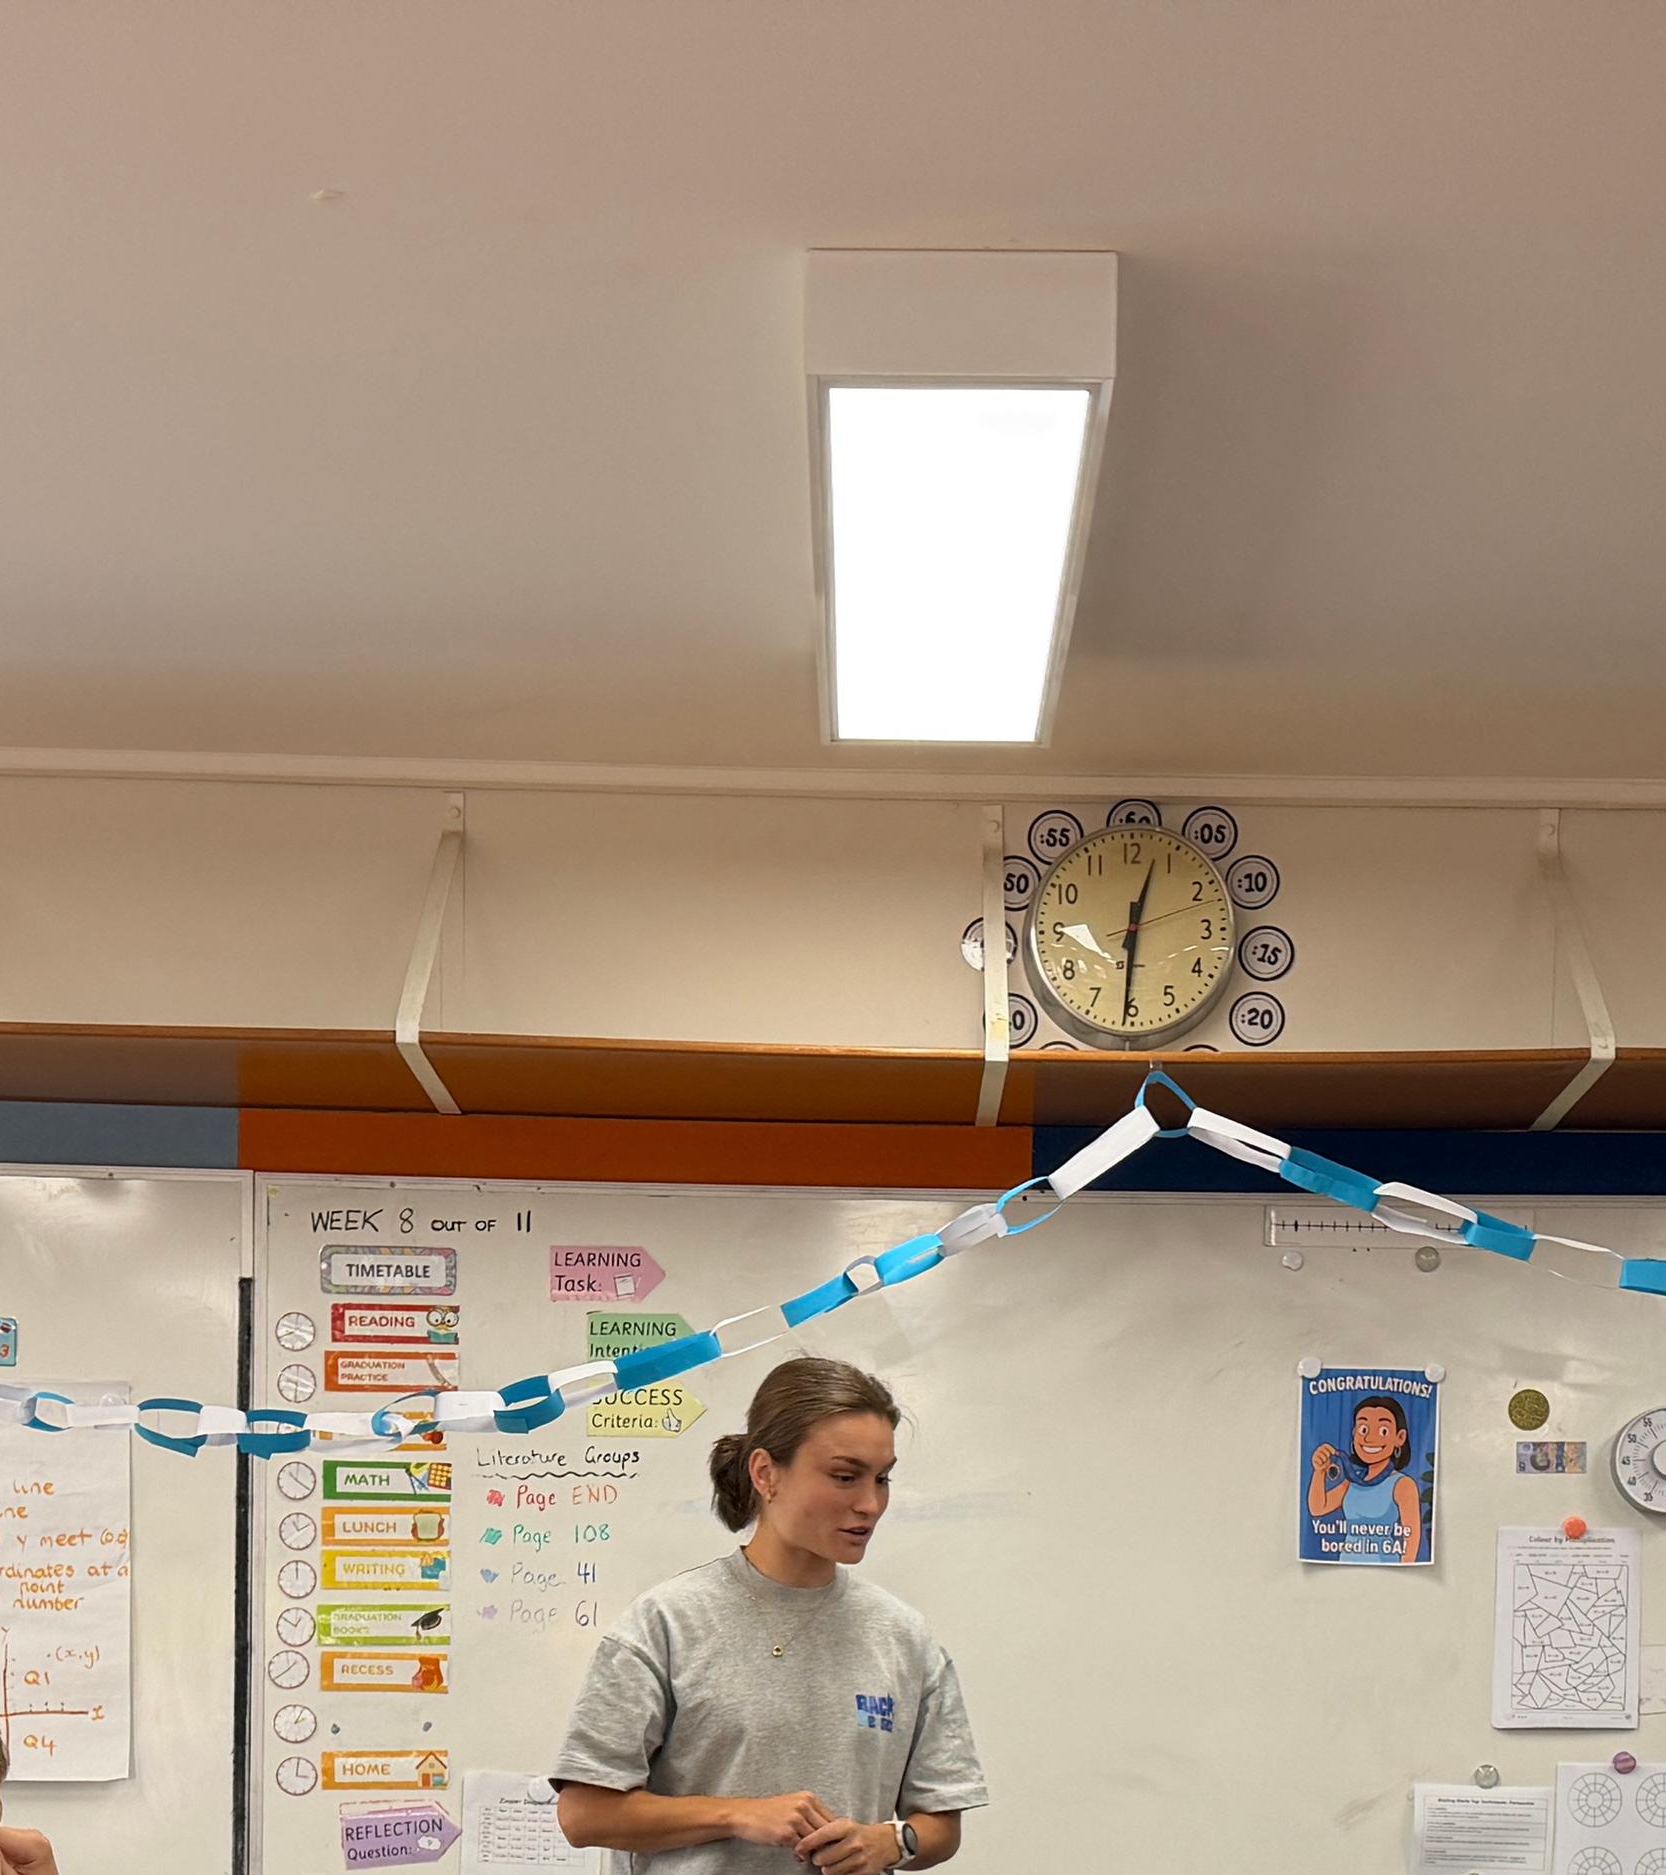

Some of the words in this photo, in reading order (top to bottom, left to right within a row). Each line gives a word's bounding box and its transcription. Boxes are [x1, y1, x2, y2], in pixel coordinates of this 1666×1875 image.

[1039, 827, 1070, 847] :55
[1194, 823, 1226, 844] :05
[1123, 843, 1142, 864] 12
[1087, 855, 1103, 875] 11
[1166, 854, 1172, 874] 1
[1057, 884, 1077, 904] 10
[1192, 882, 1203, 901] 2
[1200, 919, 1212, 939] 3
[1063, 960, 1075, 979] 8
[1192, 958, 1203, 977] 4
[1090, 987, 1101, 1007] 7
[1163, 986, 1175, 1006] 5
[1126, 998, 1139, 1018] 6
[1240, 1008, 1273, 1028] :20
[311, 1209, 383, 1232] WEEK
[399, 1208, 414, 1233] 8
[431, 1219, 466, 1232] OUT
[475, 1220, 496, 1232] OF
[554, 1252, 641, 1267] LEARNING
[346, 1264, 430, 1278] TIMETABLE
[555, 1274, 602, 1292] Task:
[348, 1316, 415, 1328] READING
[590, 1322, 676, 1336] LEARNING
[340, 1361, 405, 1369] GRADUATION
[1309, 1376, 1432, 1398] CONGRATULATIONS!
[592, 1414, 658, 1428] Criteria:
[477, 1450, 567, 1466] Literature
[585, 1446, 640, 1469] Groups
[14, 1479, 55, 1495] line
[345, 1474, 390, 1486] MATH
[516, 1485, 556, 1511] Page
[572, 1485, 618, 1505] END
[343, 1522, 396, 1533] LUNCH
[1312, 1520, 1346, 1534] You'll
[1351, 1524, 1390, 1535] never
[1394, 1523, 1411, 1536] be
[40, 1528, 93, 1547] meet
[513, 1524, 551, 1552] Page
[575, 1524, 610, 1543] 108
[1322, 1539, 1361, 1552] bored
[1366, 1540, 1378, 1552] in
[1383, 1540, 1407, 1554] 6A!
[87, 1562, 112, 1577] at
[343, 1563, 405, 1575] WRITING
[512, 1562, 565, 1592] Page
[577, 1562, 596, 1583] 41
[21, 1580, 64, 1597] point
[14, 1597, 84, 1611] number
[510, 1600, 557, 1631] Page
[575, 1601, 597, 1627] 61
[24, 1671, 50, 1685] Q1
[342, 1665, 394, 1675] RECESS
[24, 1735, 56, 1757] Q4
[342, 1764, 391, 1776] HOME
[345, 1819, 443, 1841] REFLECTION
[347, 1845, 413, 1861] Question:
